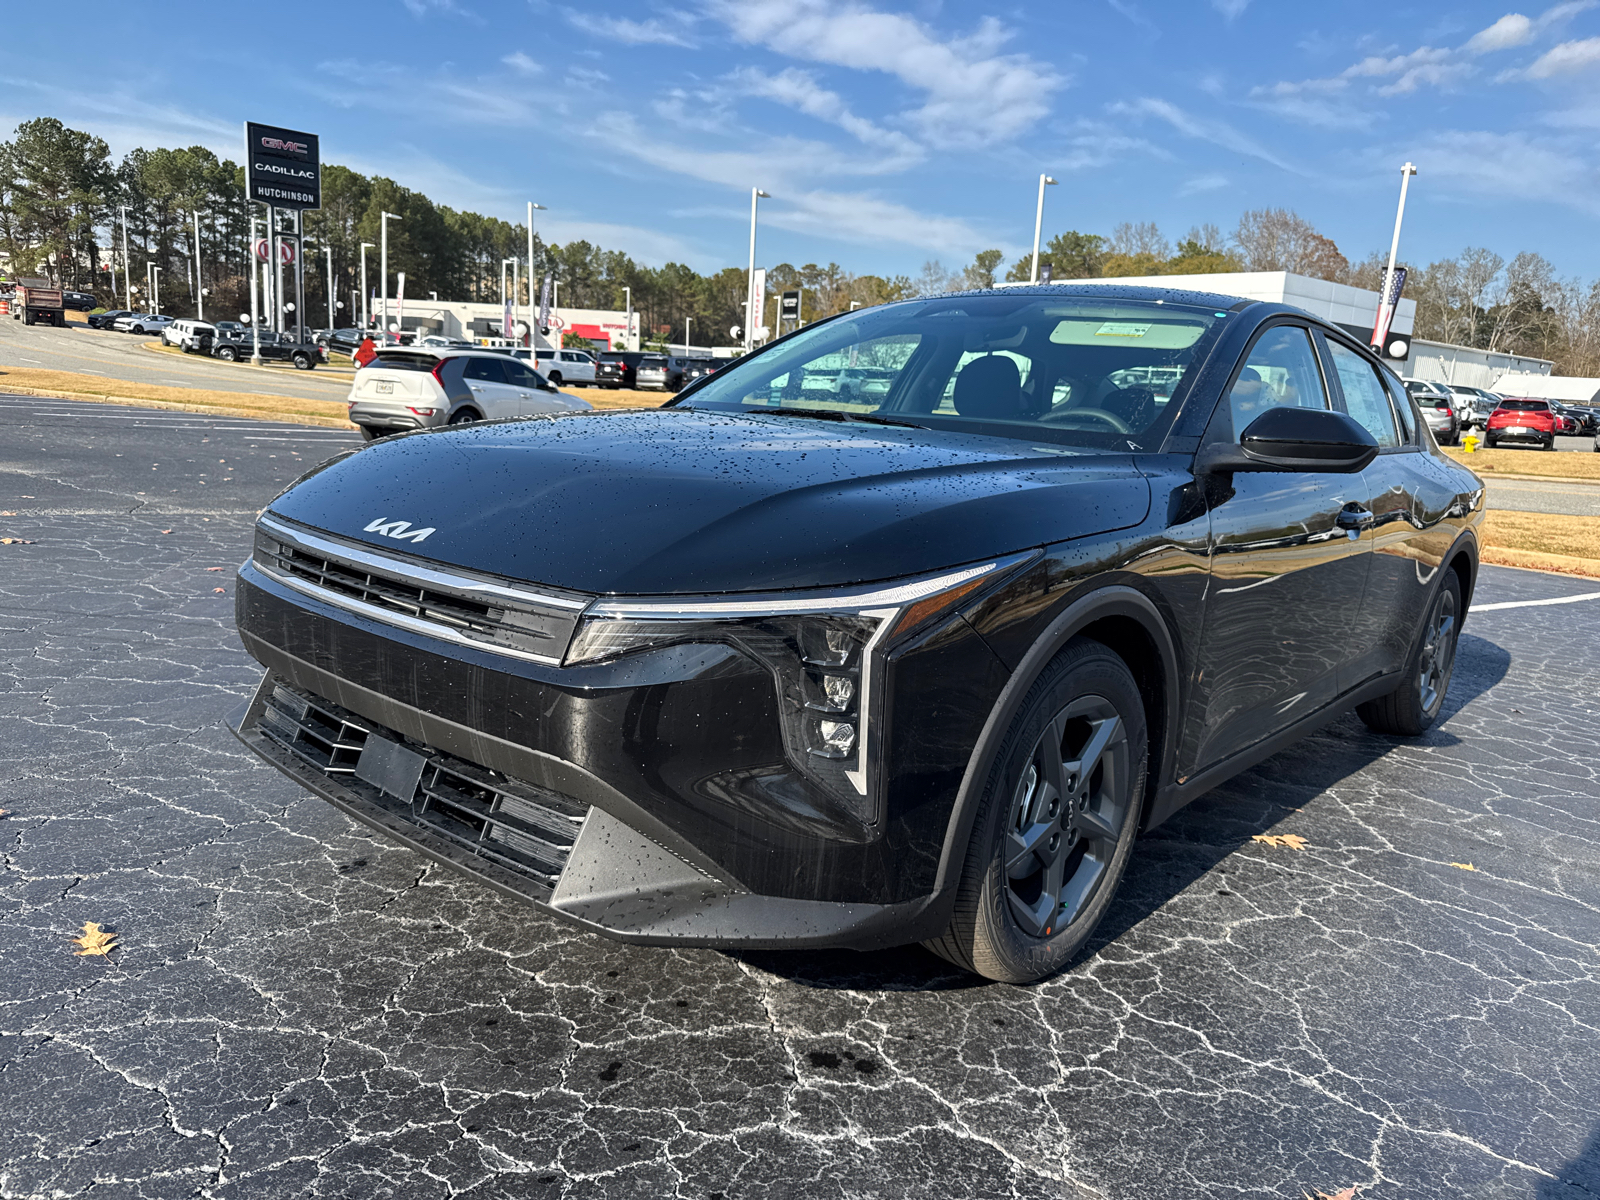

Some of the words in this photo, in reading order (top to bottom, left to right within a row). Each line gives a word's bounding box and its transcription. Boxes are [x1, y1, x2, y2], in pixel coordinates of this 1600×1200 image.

[261, 137, 308, 154] GMC
[254, 163, 315, 179] CADILLAC
[258, 186, 314, 203] HUTCHINSON
[363, 517, 437, 543] KIA
